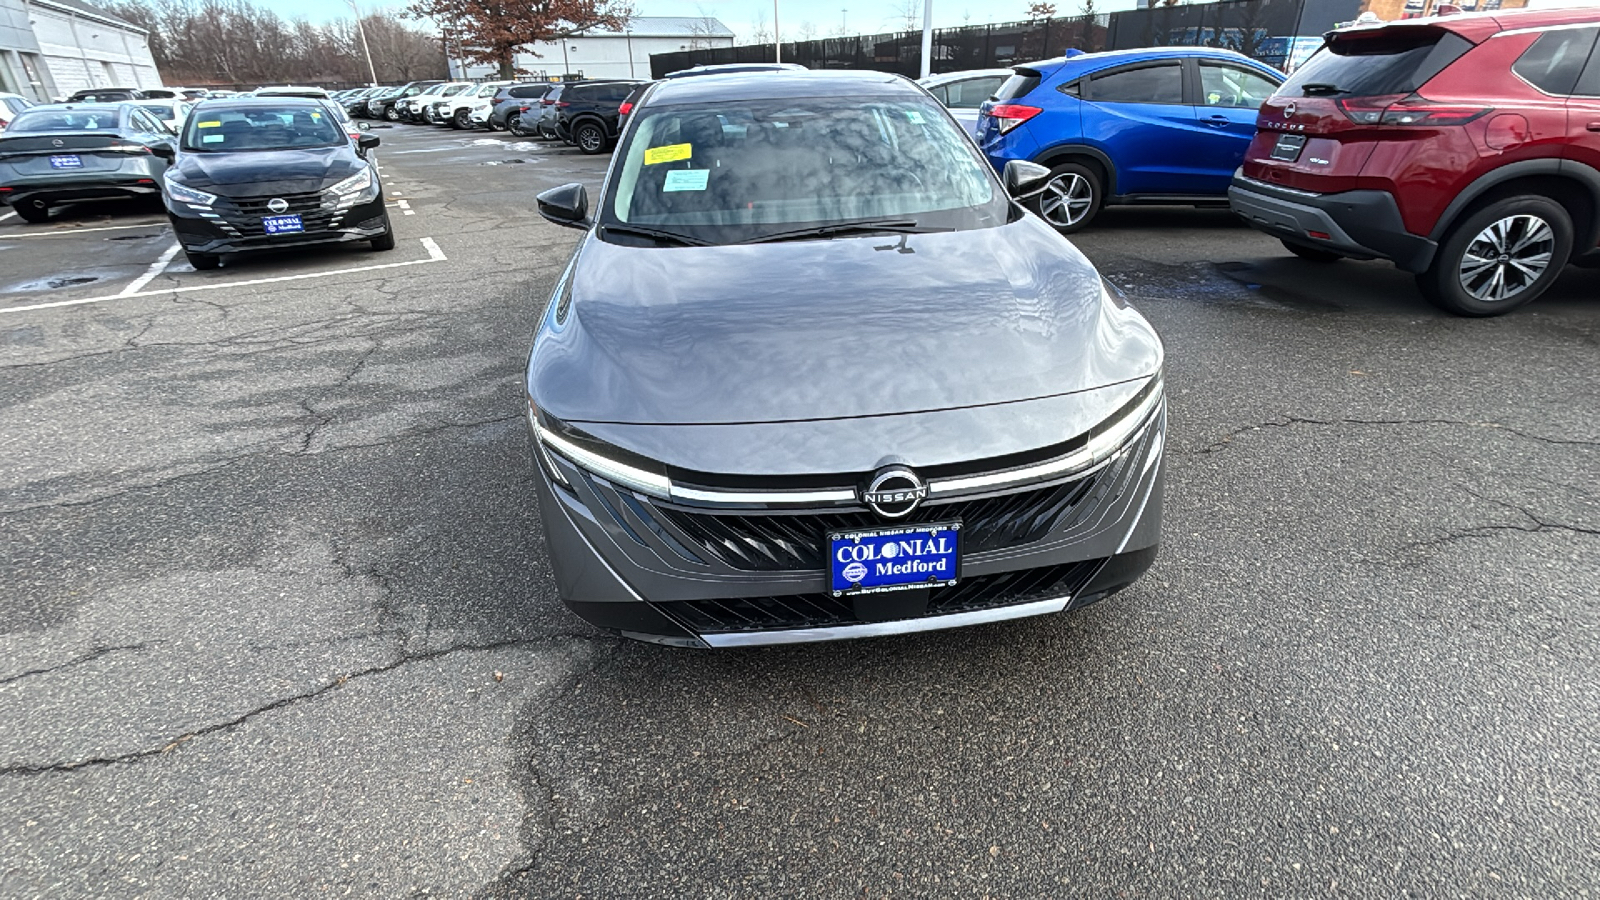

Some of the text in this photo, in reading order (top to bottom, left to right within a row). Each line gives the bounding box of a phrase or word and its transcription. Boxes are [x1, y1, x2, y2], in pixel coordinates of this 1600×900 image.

[865, 490, 926, 502] NISSAN
[844, 531, 878, 539] COLONIAL
[879, 529, 904, 537] NISSAN
[837, 538, 952, 563] COLONIAL
[876, 558, 947, 576] Medford
